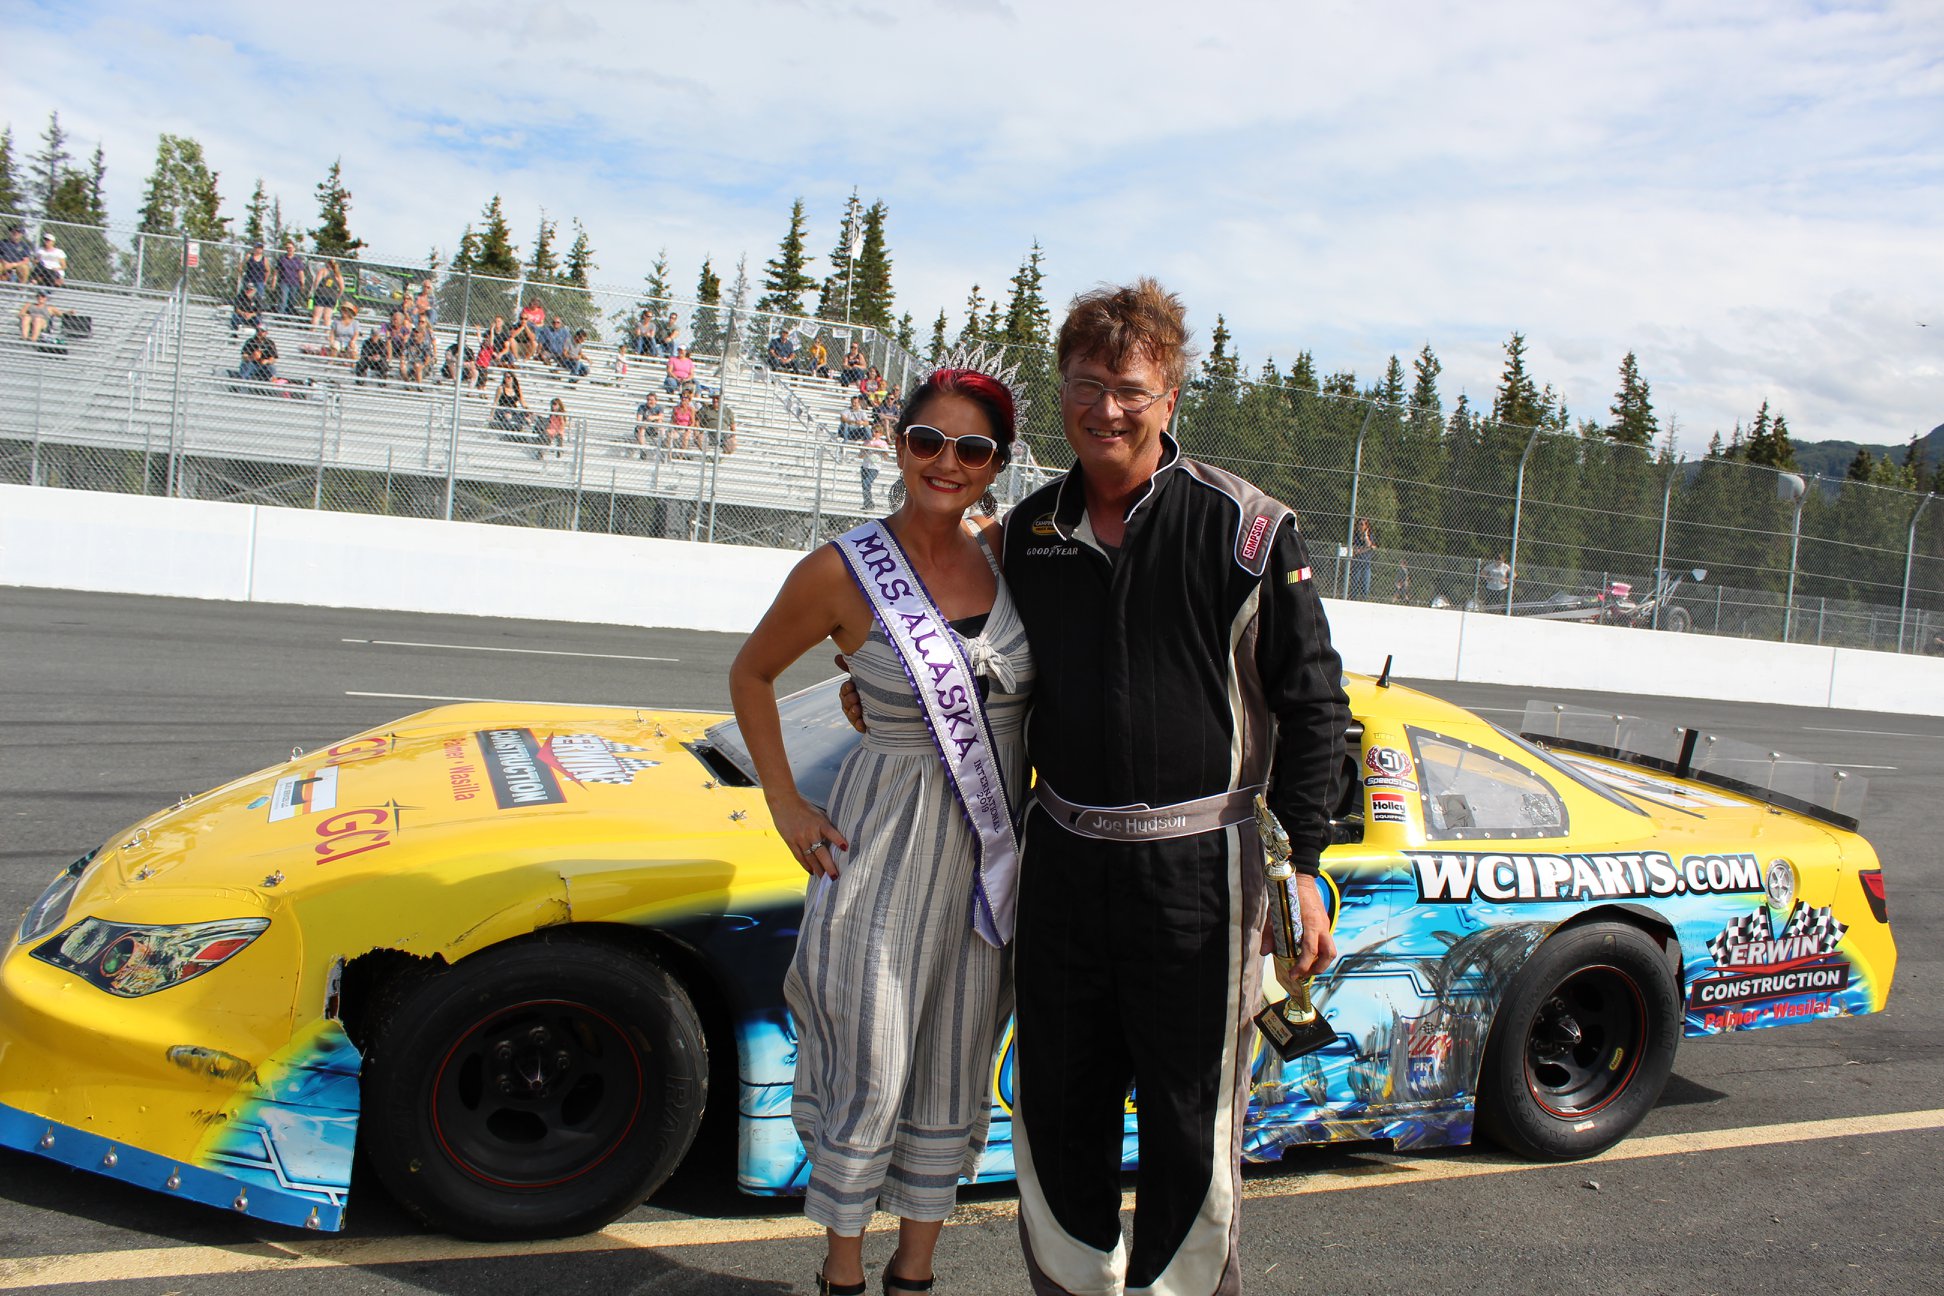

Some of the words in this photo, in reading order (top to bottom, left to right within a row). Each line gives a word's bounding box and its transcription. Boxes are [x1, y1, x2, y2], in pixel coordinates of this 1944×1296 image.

[1244, 518, 1265, 558] SIMPSON
[851, 531, 914, 606] MRS.
[897, 611, 980, 764] ALASKA
[489, 730, 549, 803] CONSTRUCTION
[551, 735, 627, 780] ERWIN
[1381, 750, 1401, 771] 51
[449, 764, 481, 802] Wasilla
[973, 759, 1000, 835] INTERNATIONAL
[976, 791, 990, 813] 2019
[1092, 815, 1122, 832] Joe
[1125, 815, 1187, 834] Hudson
[1373, 801, 1406, 814] Holley
[314, 808, 391, 866] GCI
[1411, 852, 1762, 900] WCIPARTS.COM
[1729, 934, 1821, 966] ERWIN
[1700, 970, 1841, 1002] CONSTRUCTION
[1703, 1010, 1761, 1030] Palmer
